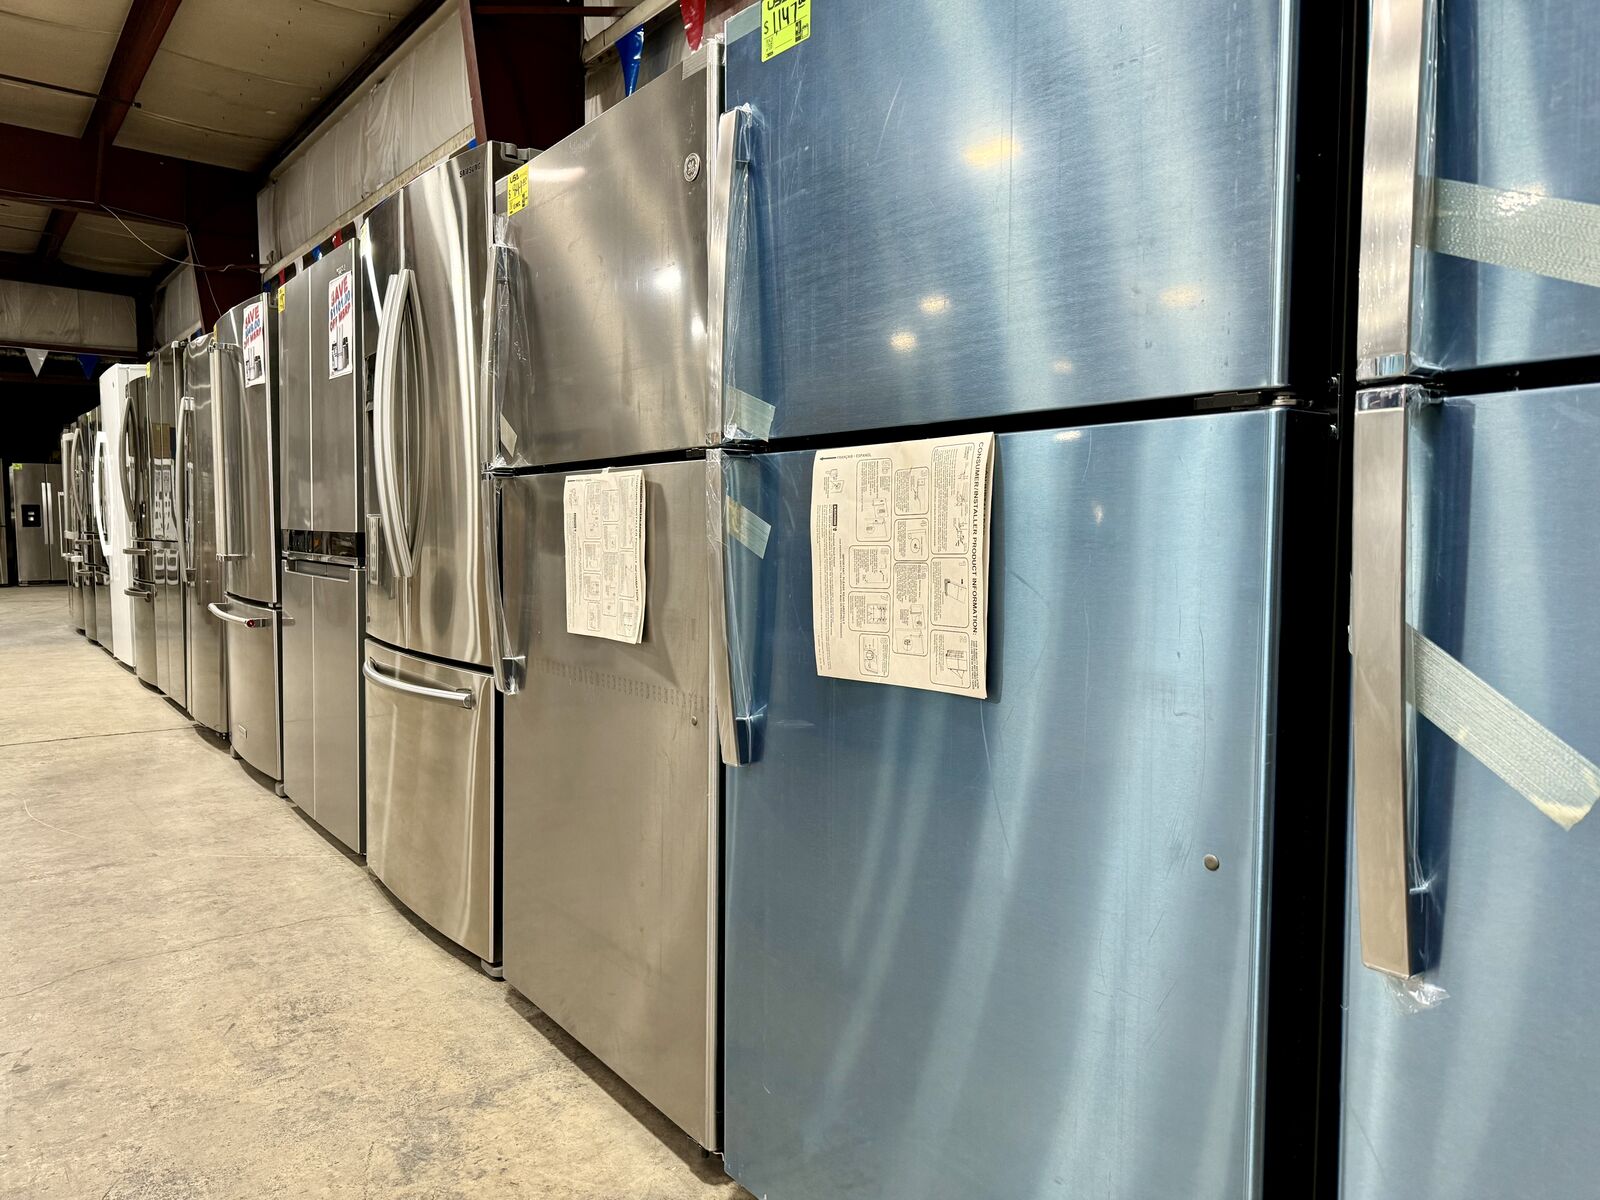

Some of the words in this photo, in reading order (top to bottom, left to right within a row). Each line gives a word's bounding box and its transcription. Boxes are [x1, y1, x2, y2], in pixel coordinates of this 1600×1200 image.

[459, 162, 481, 179] SAMSUNG
[331, 275, 349, 307] SAVE
[338, 302, 351, 322] MSRP
[972, 441, 984, 535] CONSUMER/INSTALLER
